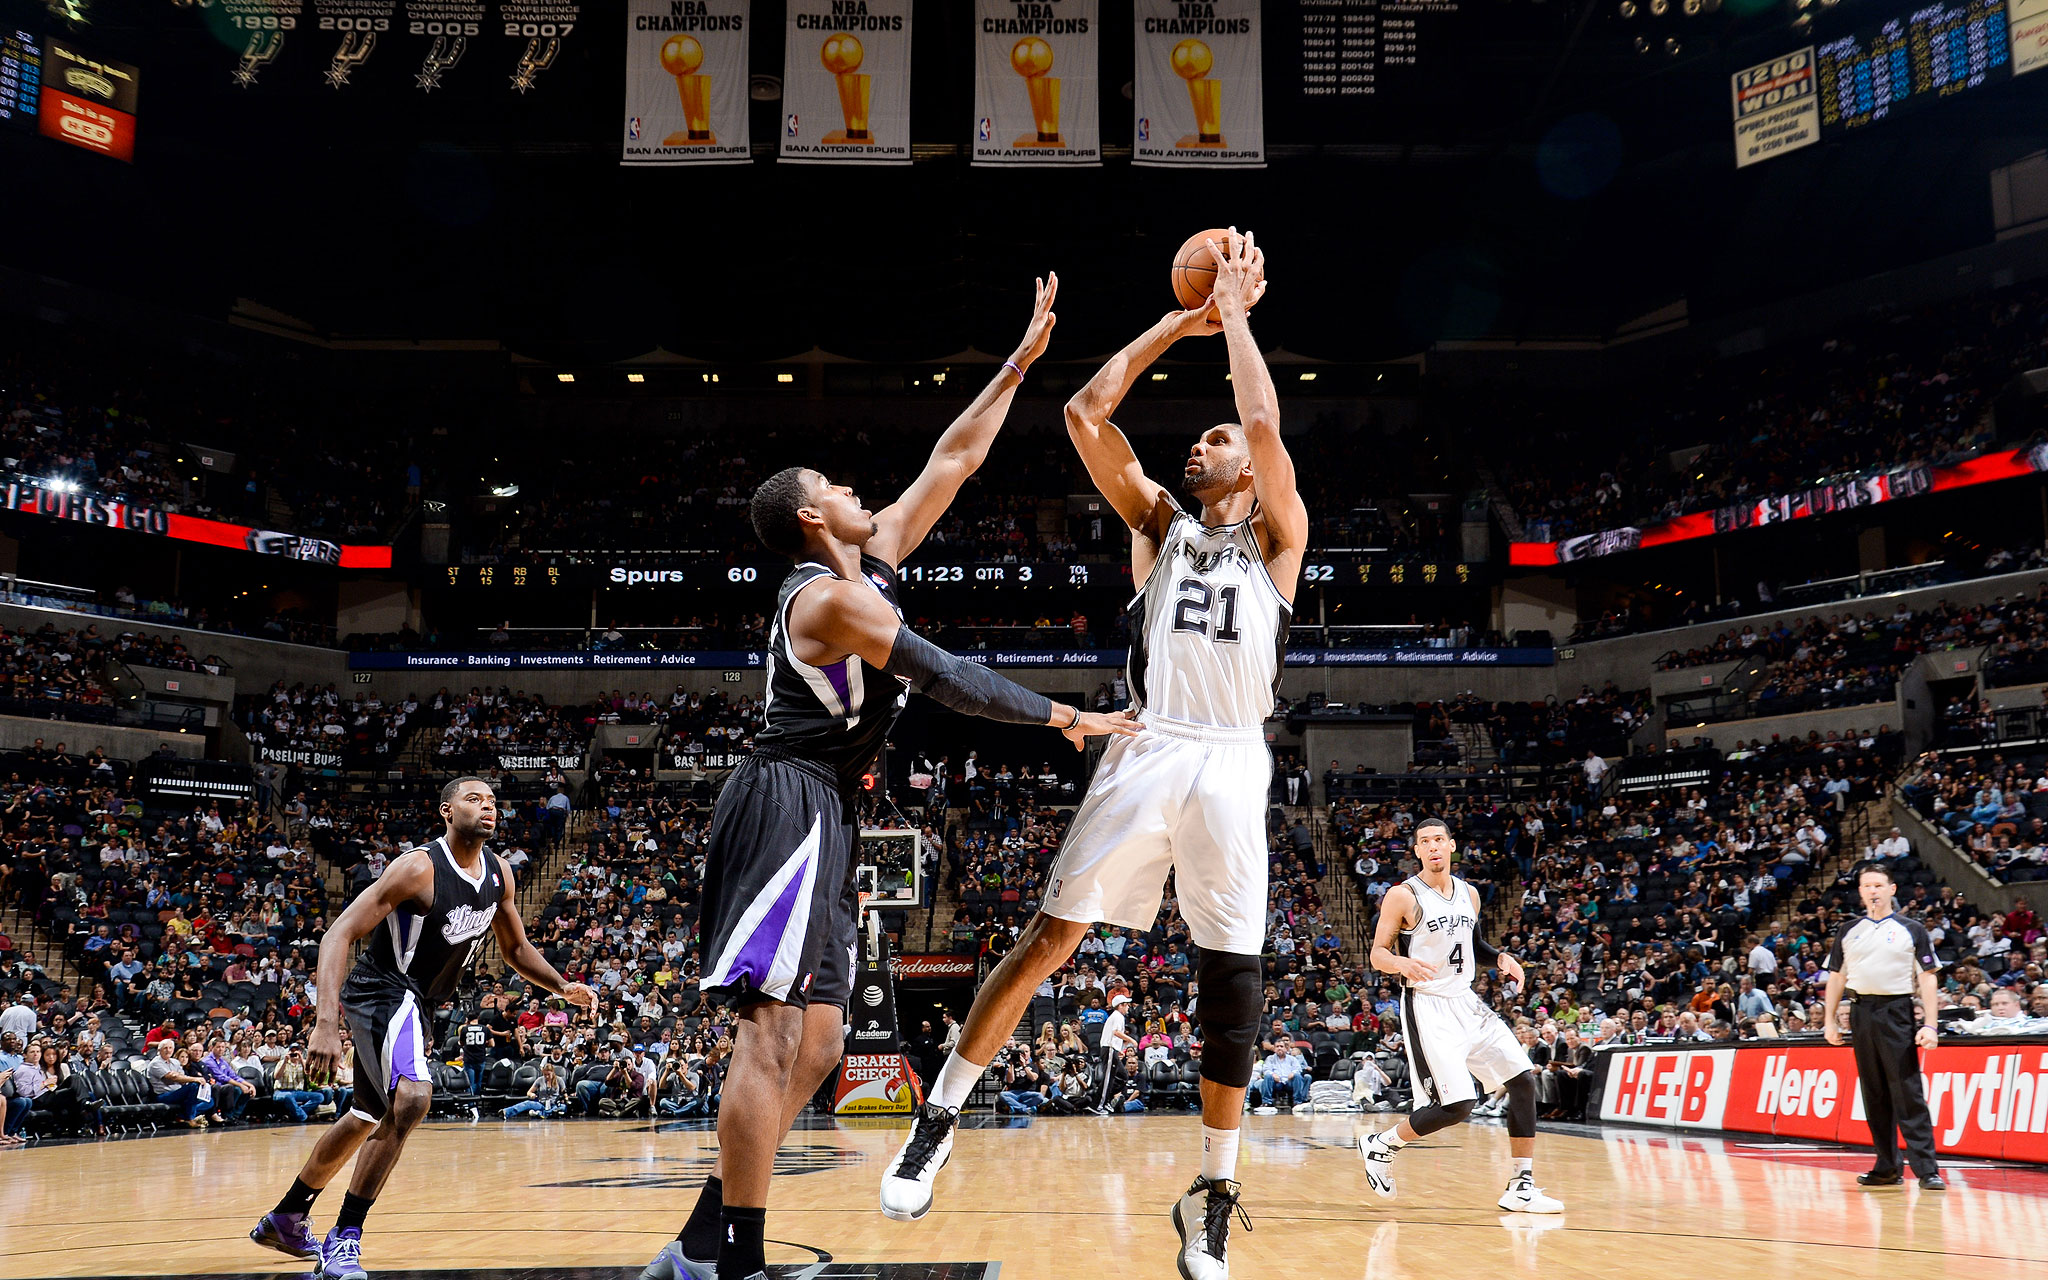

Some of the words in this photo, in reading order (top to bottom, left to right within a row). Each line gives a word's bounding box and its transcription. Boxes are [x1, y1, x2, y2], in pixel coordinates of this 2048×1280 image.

[225, 6, 302, 15] CHAMPIONS
[316, 7, 393, 16] CHAMPIONS
[405, 2, 486, 12] CONFERENCE
[499, 4, 580, 14] CONFERENCE
[671, 1, 707, 15] NBA
[832, 1, 868, 15] NBA
[1017, 4, 1054, 18] NBA
[1178, 4, 1215, 18] NBA
[1380, 3, 1424, 11] DIVISION
[1427, 3, 1459, 11] TITLES
[230, 15, 297, 30] 1999
[407, 12, 483, 21] CHAMPIONS
[502, 13, 577, 22] CHAMPIONS
[636, 15, 743, 31] CHAMPIONS
[797, 14, 903, 31] CHAMPIONS
[319, 16, 390, 32] 2003
[409, 22, 480, 35] 2005
[504, 23, 574, 37] 2007
[983, 18, 1089, 34] CHAMPIONS
[1145, 18, 1250, 34] CHAMPIONS
[1738, 52, 1807, 89] 1200
[1741, 80, 1809, 113] WOAI
[1738, 117, 1766, 135] SPURS
[1755, 119, 1799, 142] COVERAGE
[626, 146, 652, 154] SAN
[654, 146, 707, 154] ANTONIO
[709, 145, 747, 154] SPURS
[785, 145, 811, 153] SAN
[813, 145, 864, 153] ANTONIO
[866, 145, 905, 154] SPURS
[1004, 149, 1056, 157] ANTONIO
[1058, 149, 1096, 157] SPURS
[1139, 148, 1164, 156] SAN
[1166, 149, 1217, 158] ANTONIO
[1220, 150, 1259, 158] SPURS
[123, 504, 170, 535] GO
[447, 567, 460, 576] ST
[480, 567, 493, 576] AS
[513, 567, 527, 576] RB
[548, 567, 560, 576] BL
[610, 567, 684, 585] Spurs
[727, 567, 757, 582] 60
[897, 566, 964, 582] 11:23
[975, 568, 1004, 582] QTR
[1019, 567, 1033, 581] 3
[1069, 566, 1088, 575] TOL
[1304, 565, 1335, 581] 52
[1390, 564, 1404, 575] AS
[1422, 564, 1437, 575] RB
[1456, 564, 1470, 575] BL
[449, 577, 456, 585] 3
[481, 577, 492, 585] 15
[514, 577, 526, 585] 22
[551, 577, 557, 585] 5
[1069, 575, 1088, 584] 4:1
[1172, 576, 1242, 644] 21
[407, 655, 458, 666] Insurance
[468, 655, 511, 667] Banking
[520, 655, 584, 665] Investments
[593, 655, 651, 665] Retirement
[660, 655, 696, 665] Advice
[996, 652, 1054, 663] Retirement
[1063, 652, 1098, 663] Advice
[1284, 652, 1316, 665] nking
[1324, 652, 1388, 662] Investments
[1395, 652, 1454, 662] Retirement
[1462, 652, 1498, 662] Advice
[1559, 650, 1576, 660] 102
[354, 673, 373, 684] 127
[723, 672, 741, 683] 128
[314, 752, 342, 767] BUMS
[498, 755, 547, 770] BASELINE
[441, 902, 498, 945] King
[1427, 915, 1475, 936] SPURS
[1447, 942, 1464, 975] 4
[465, 1032, 485, 1046] 20
[855, 1029, 893, 1039] Academy
[846, 1055, 901, 1068] BRAKE
[845, 1068, 901, 1081] CHECK
[1756, 1055, 1838, 1119] Here
[1851, 1053, 2048, 1147] rythi
[880, 1104, 896, 1112] Every
[896, 1103, 909, 1111] Day!
